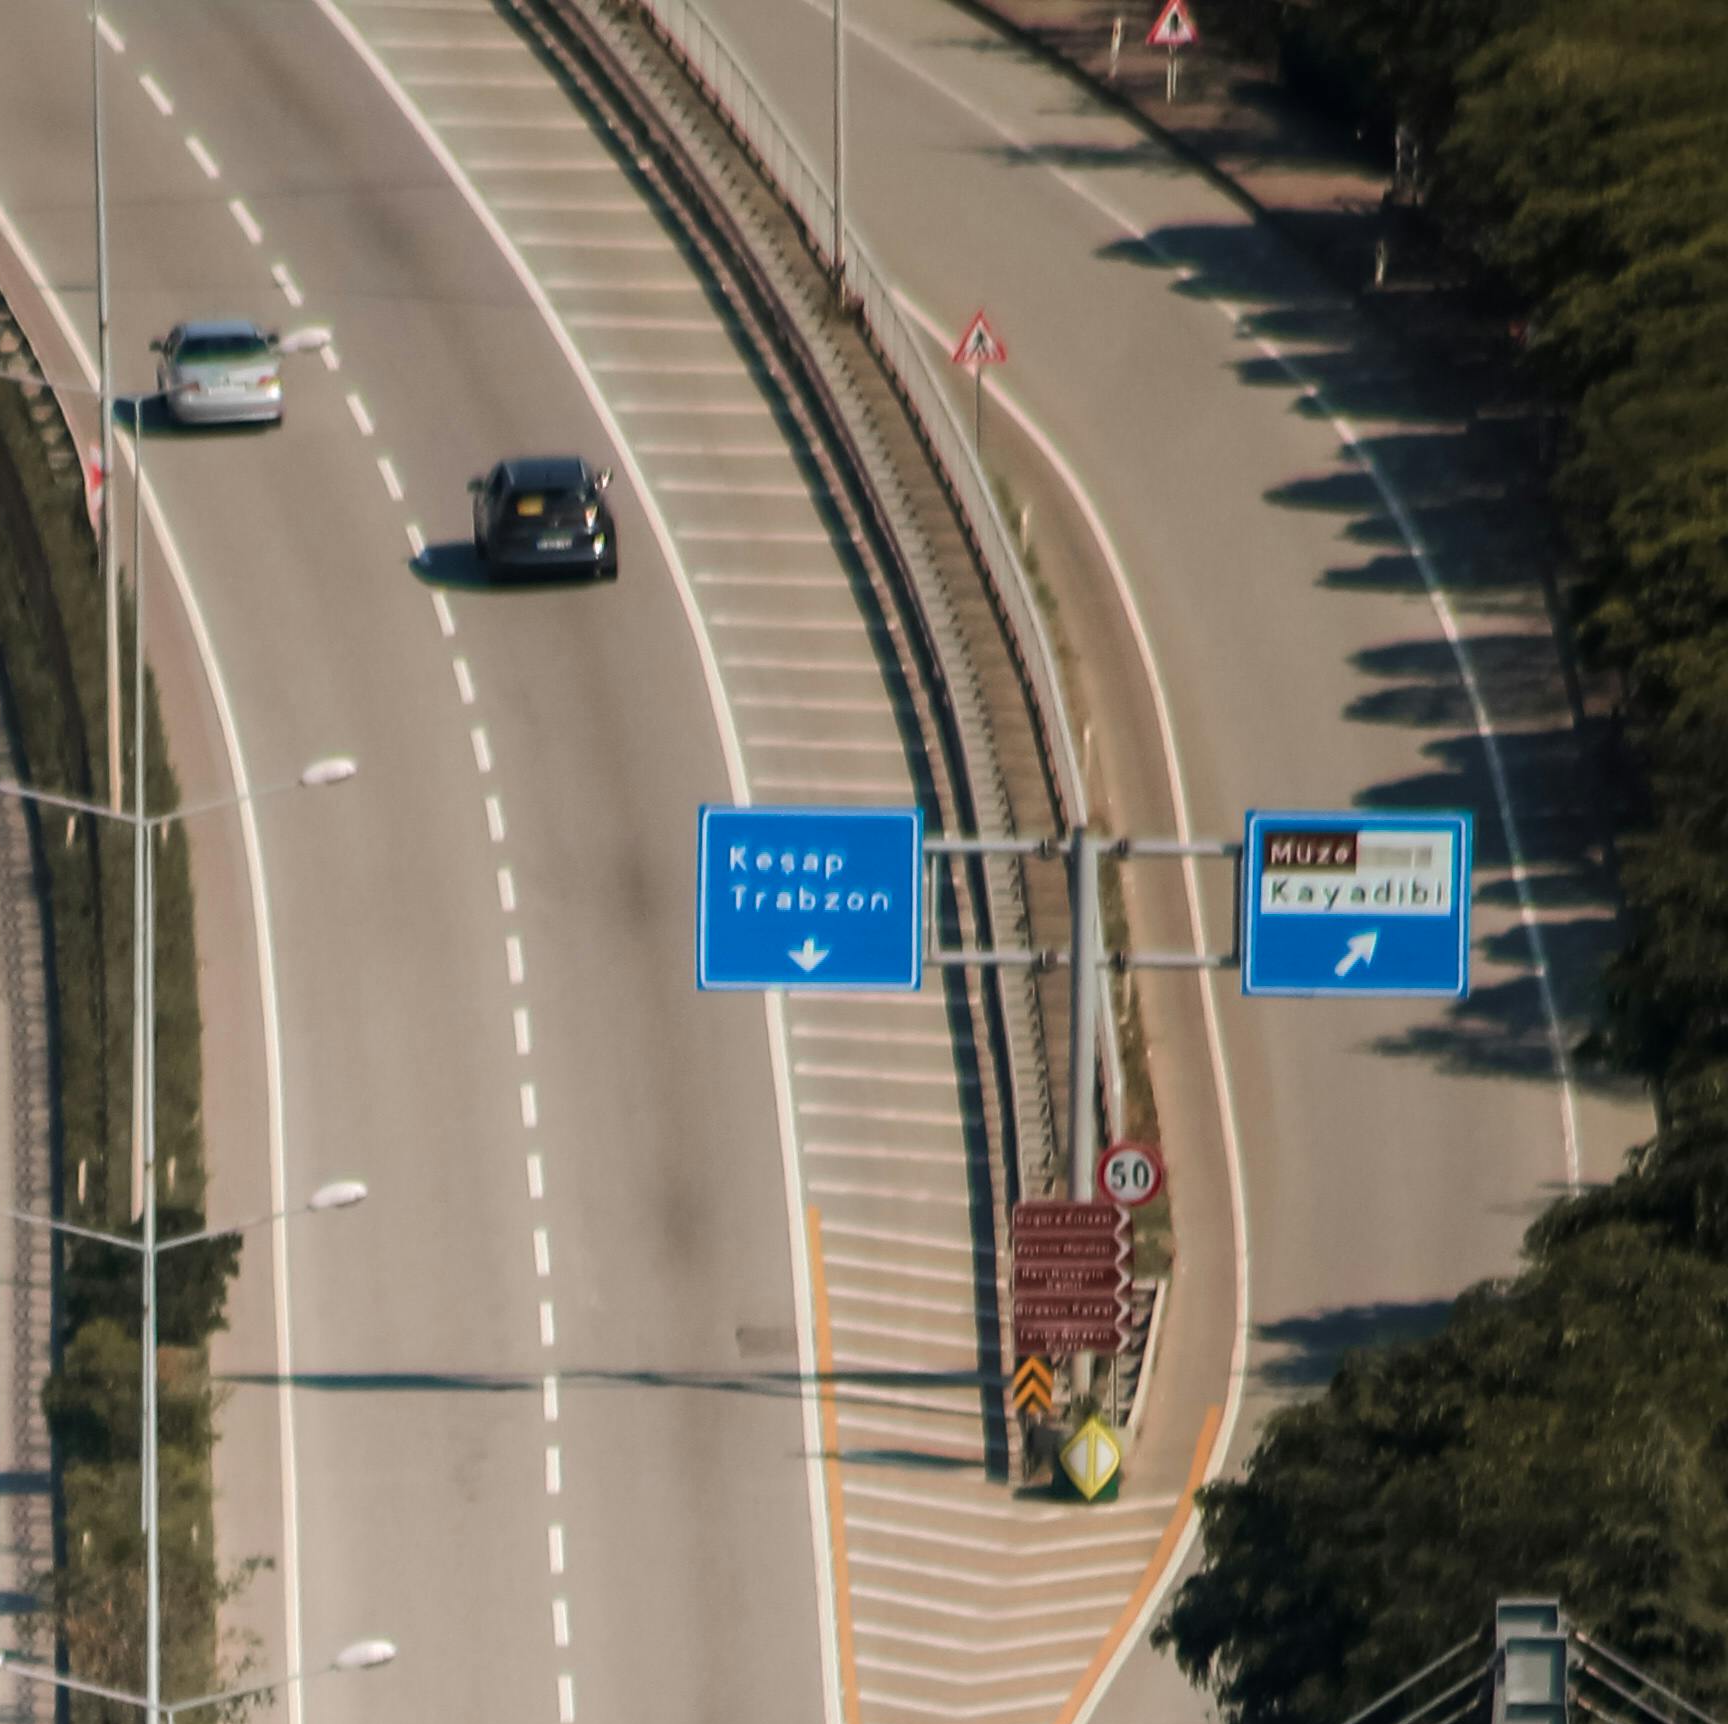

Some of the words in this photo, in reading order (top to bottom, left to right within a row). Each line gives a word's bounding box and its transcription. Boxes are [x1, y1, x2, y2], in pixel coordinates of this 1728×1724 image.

[731, 884, 889, 912] Trabzon
[1270, 879, 1442, 911] Kayadibi
[1112, 1160, 1150, 1190] 50
